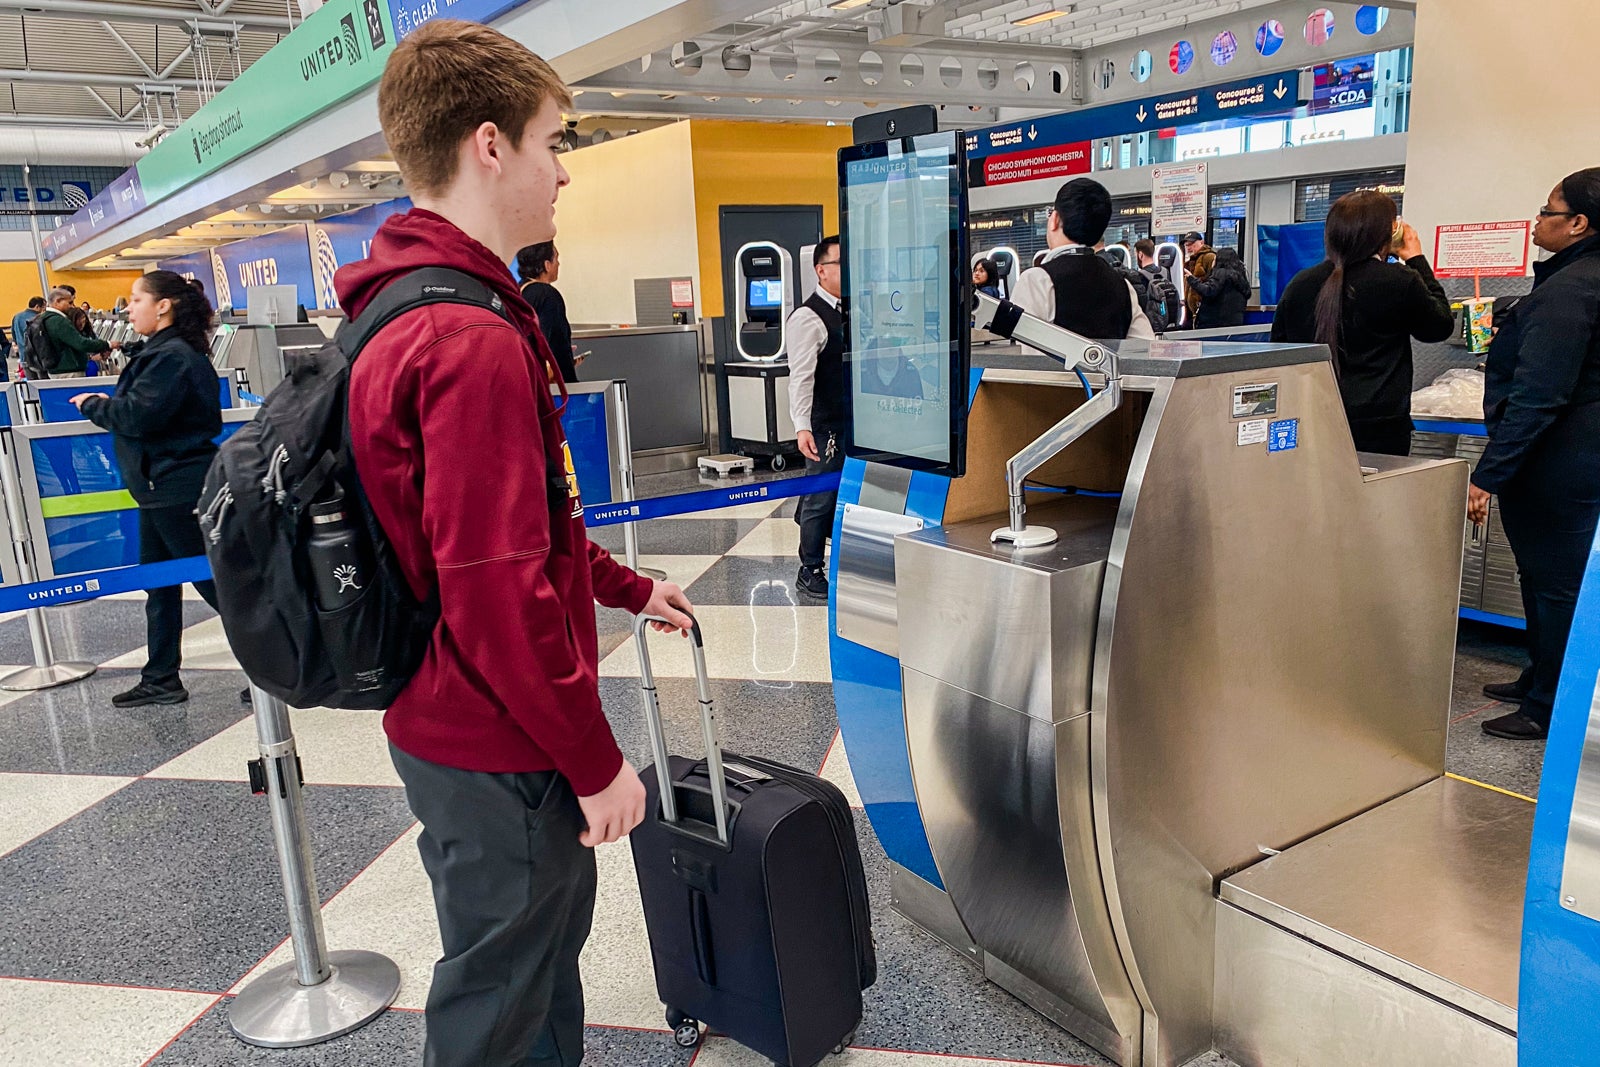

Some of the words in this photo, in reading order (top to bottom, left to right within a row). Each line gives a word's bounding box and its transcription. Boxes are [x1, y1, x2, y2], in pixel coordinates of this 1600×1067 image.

[412, 0, 438, 26] CLEAR
[300, 35, 343, 81] UNITED
[1216, 88, 1255, 100] Concourse
[1338, 88, 1367, 104] CDA
[1155, 99, 1190, 111] Concourse
[1218, 99, 1237, 109] Gates
[1158, 110, 1175, 119] Gates
[198, 131, 212, 155] Bag
[219, 106, 243, 140] shortcut
[990, 131, 1016, 140] Concourse
[988, 161, 1014, 171] CHICAGO
[1014, 156, 1047, 168] SYMPHONY
[1047, 150, 1084, 163] ORCHESTRA
[873, 162, 907, 174] UNITED
[988, 171, 1017, 181] RICCARDO
[1018, 169, 1032, 177] MUTI
[238, 257, 278, 288] UNITED
[729, 490, 759, 500] UNITED
[594, 508, 630, 519] UNITED
[28, 584, 84, 600] UNITED
